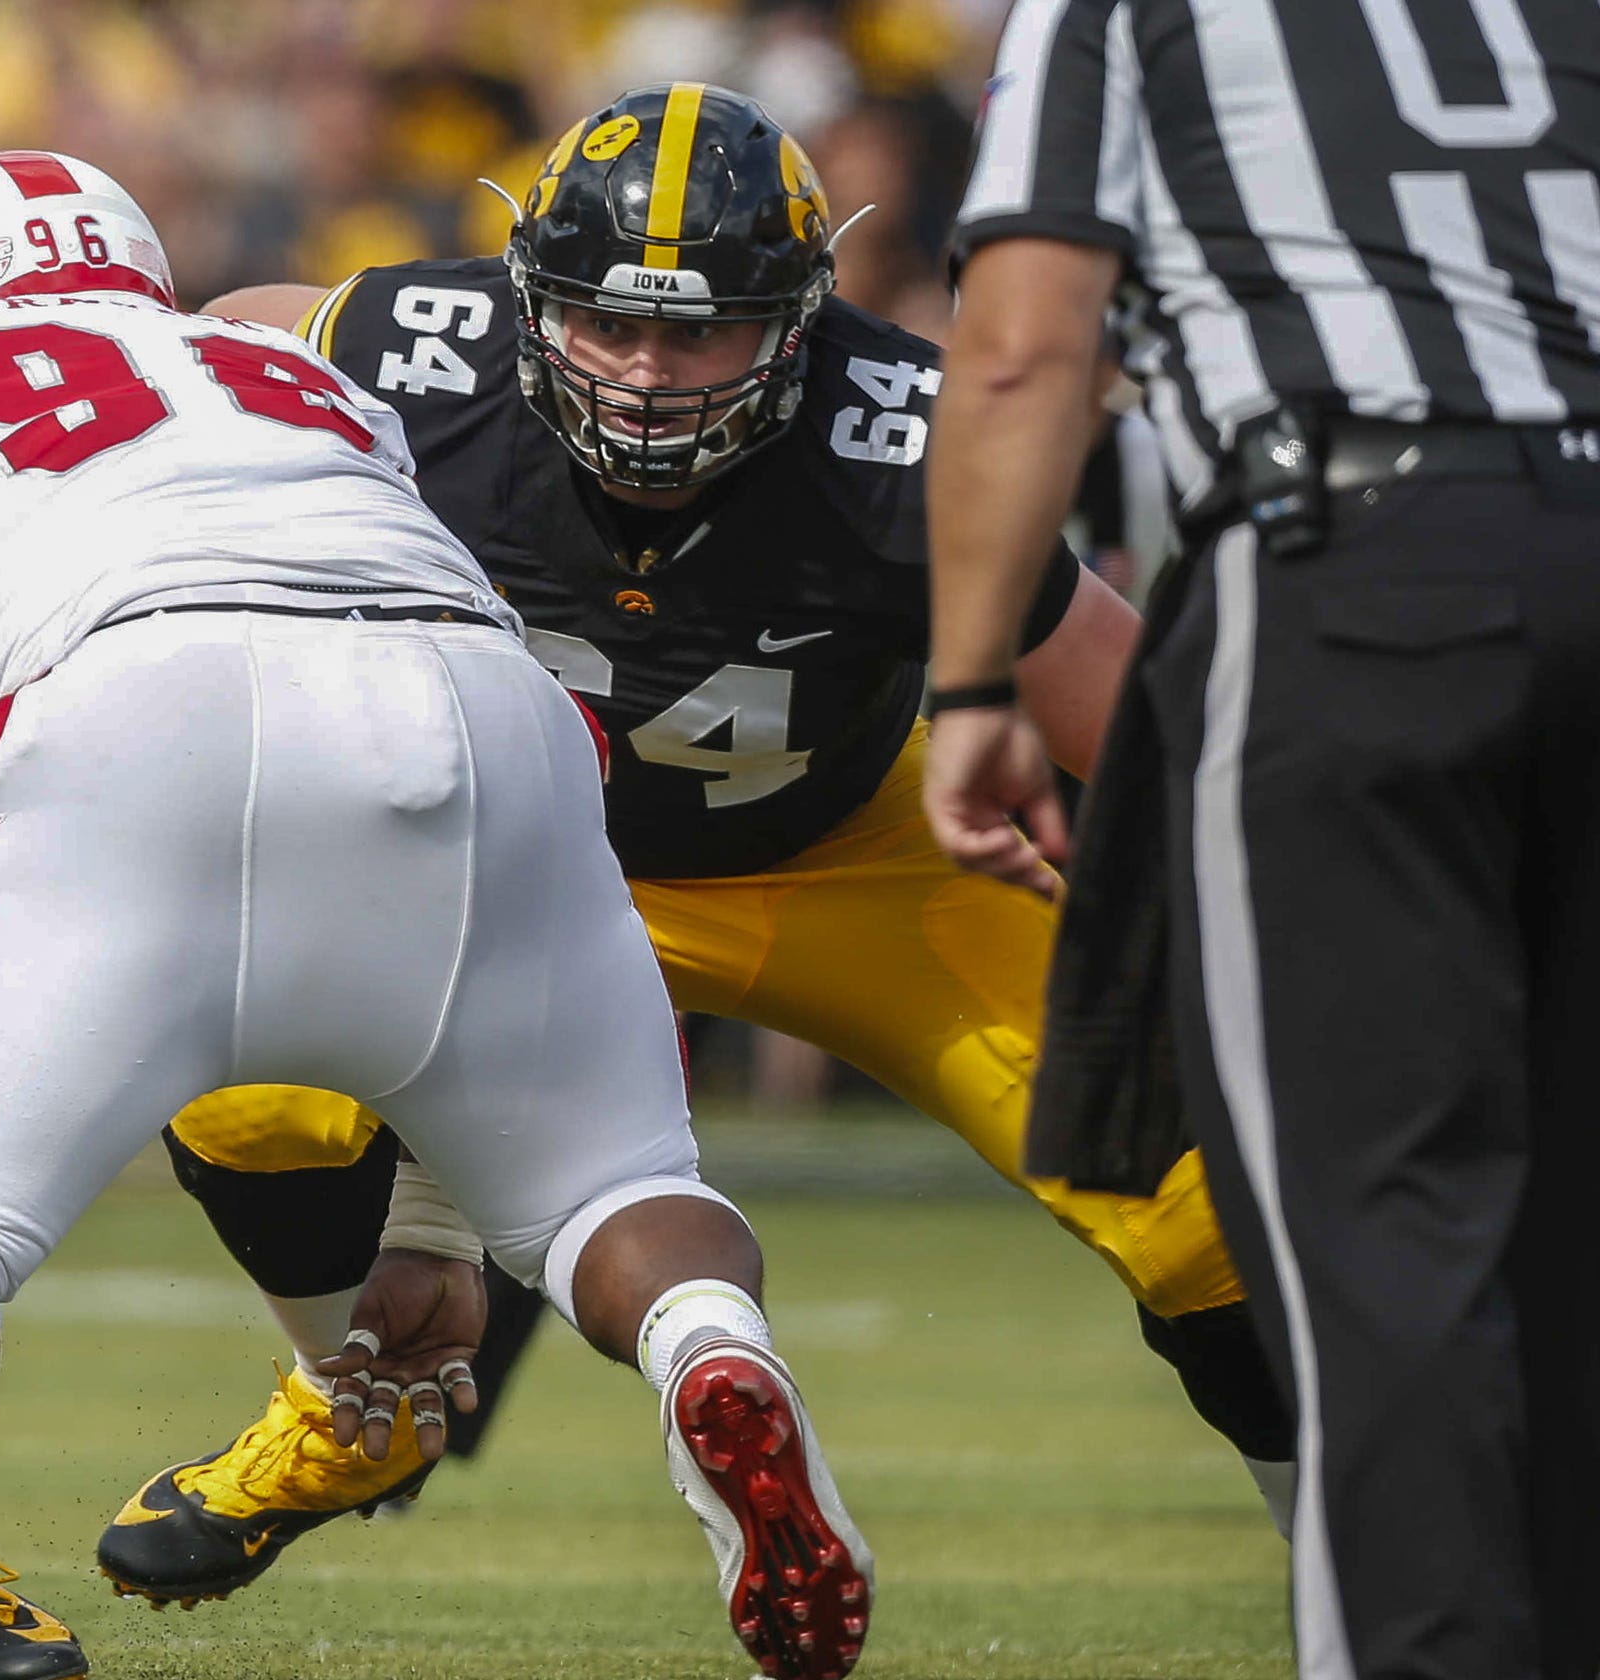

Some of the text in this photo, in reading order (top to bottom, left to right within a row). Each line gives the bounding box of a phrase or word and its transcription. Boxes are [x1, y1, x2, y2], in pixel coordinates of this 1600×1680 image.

[24, 215, 108, 269] 96
[632, 272, 680, 292] IOWA
[376, 285, 493, 396] 64
[830, 356, 944, 465] 64
